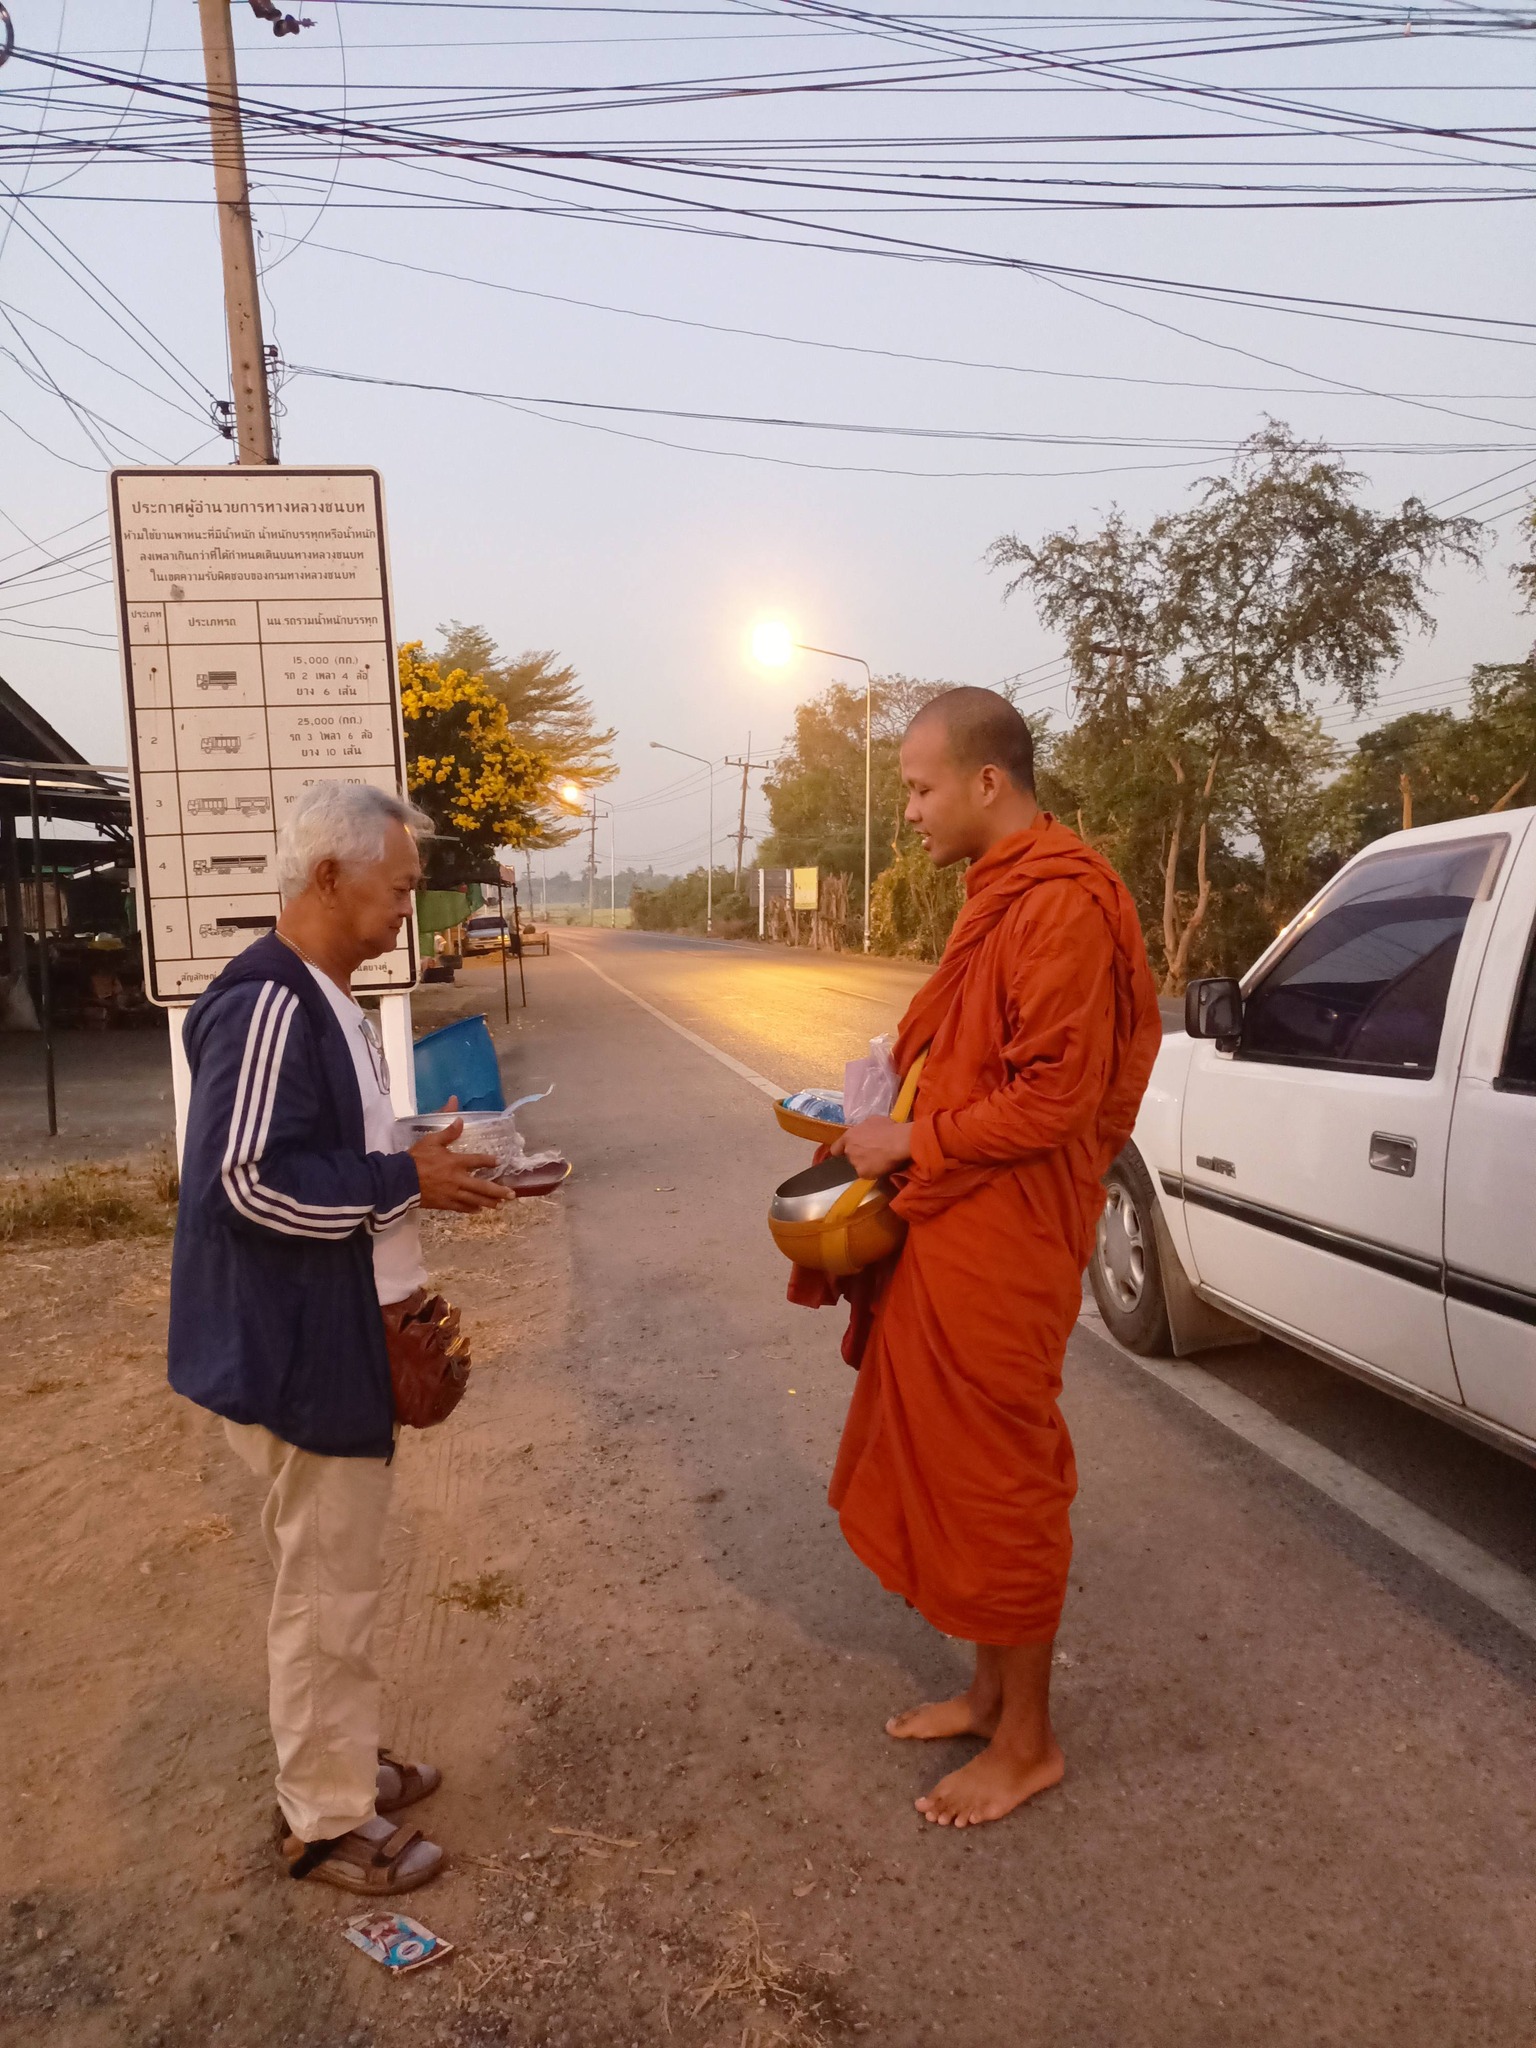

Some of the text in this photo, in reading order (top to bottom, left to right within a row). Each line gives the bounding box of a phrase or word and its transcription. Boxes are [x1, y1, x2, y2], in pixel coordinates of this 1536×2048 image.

[132, 499, 365, 517] ประกาศผู้อำนวยการทางหลวงชนบท
[124, 526, 376, 542] ห้ามใช้ยานพาหนะที่มีน้ำหนัก น้ำหนักบรรทุกหรือน้ำหนัก
[150, 568, 356, 581] ในเขตความรับผิดชอบของกรมทางหลวงชนบท
[131, 611, 162, 619] ประเภท
[188, 617, 236, 627] ประเภทรถ
[284, 669, 368, 680] รถ 2 เพลา 4 ล้อ
[296, 688, 315, 696] ยาง
[338, 685, 357, 696] เส้น
[297, 717, 335, 726] 25,000
[289, 733, 301, 741] รถ
[307, 733, 313, 741] 3
[347, 732, 353, 740] 6
[361, 729, 373, 740] ล้อ
[301, 744, 362, 757] ยาง 10 เส้น
[155, 799, 163, 807] 3
[158, 862, 166, 870] 4
